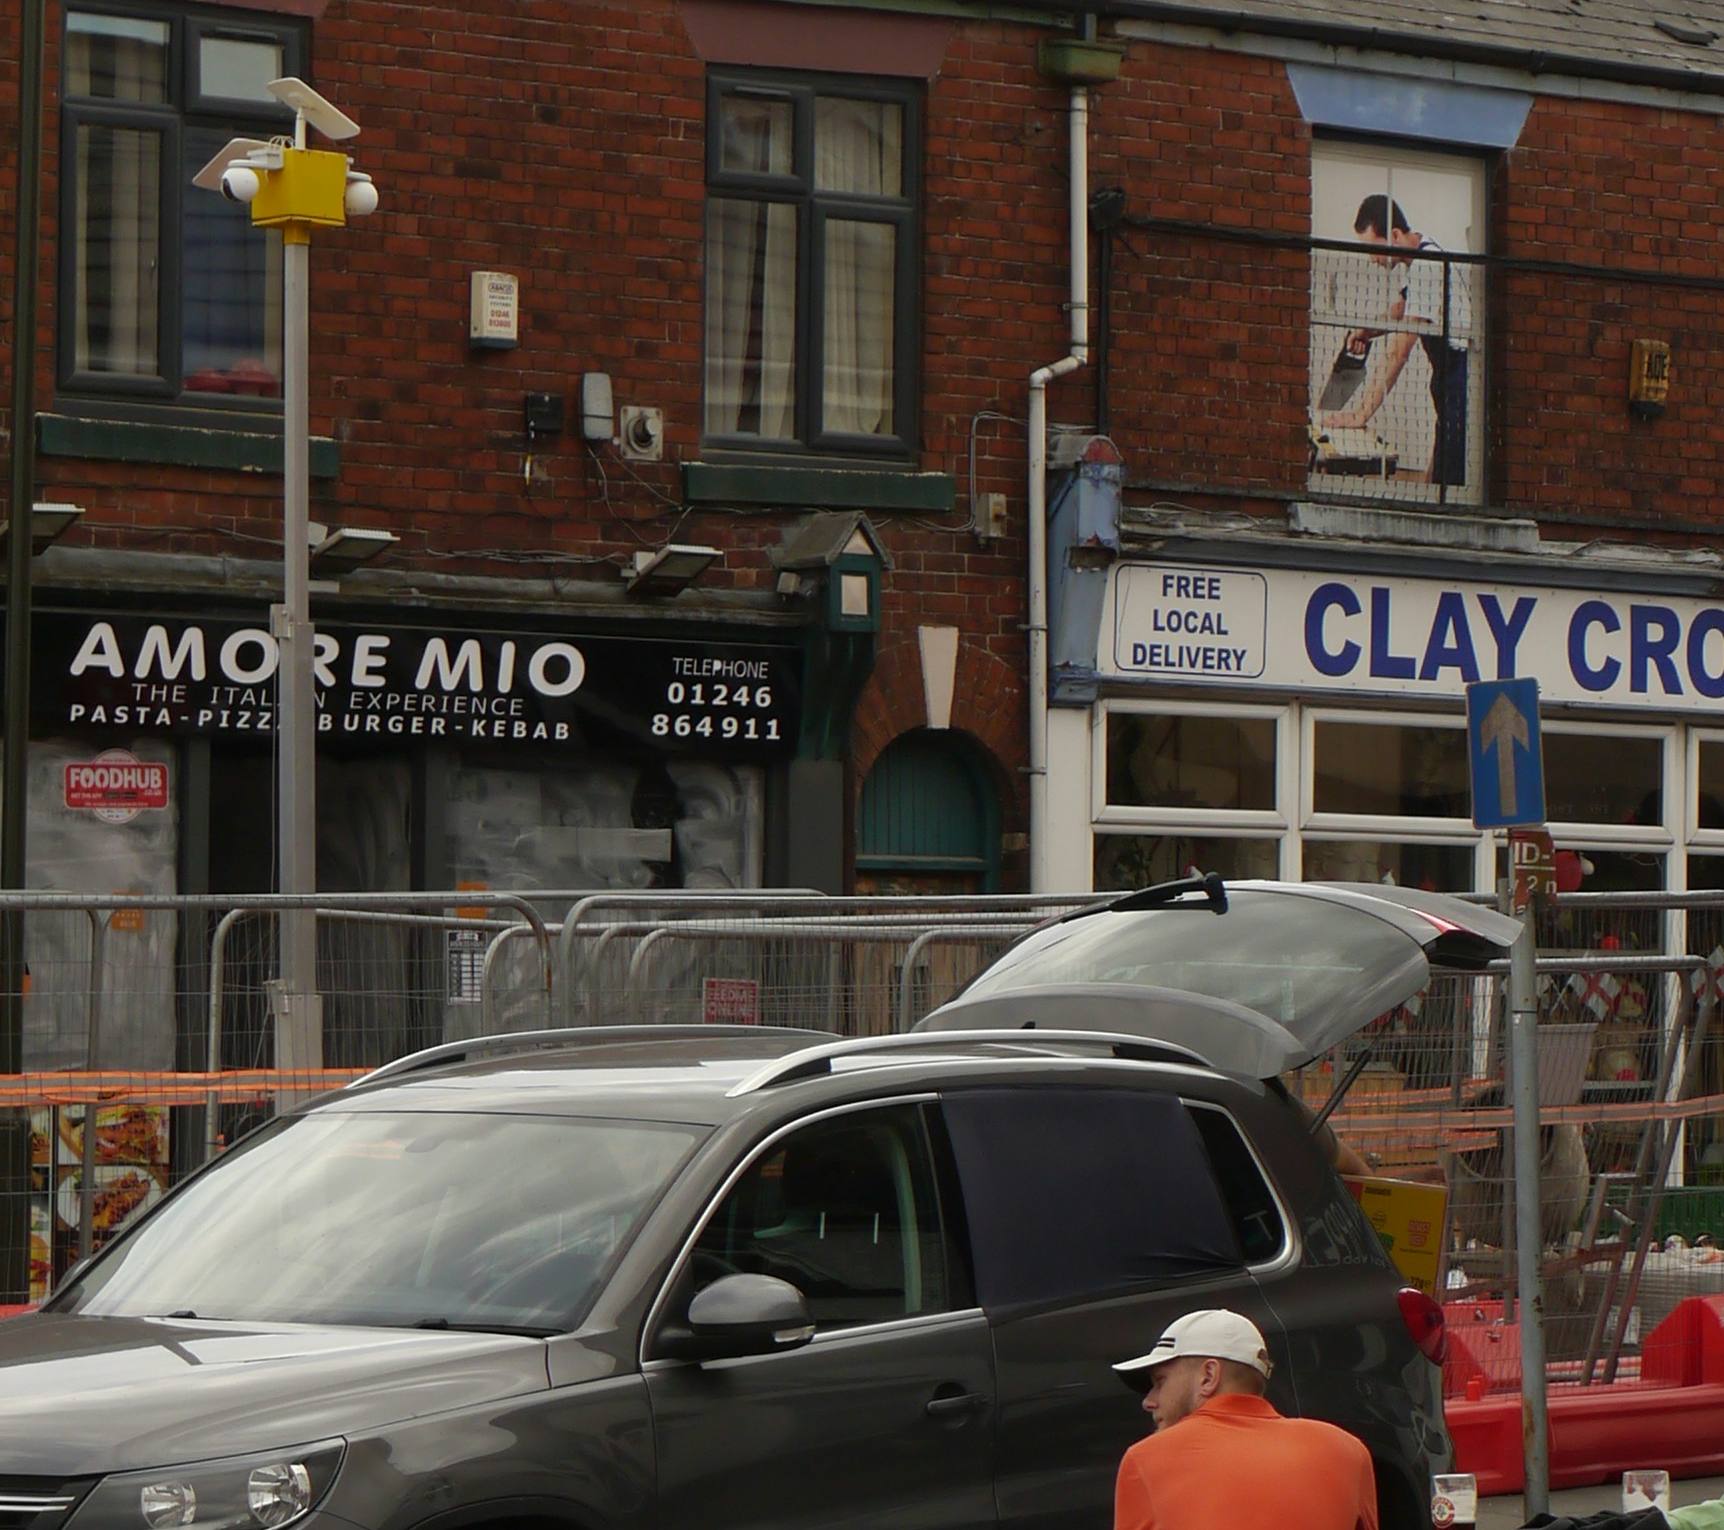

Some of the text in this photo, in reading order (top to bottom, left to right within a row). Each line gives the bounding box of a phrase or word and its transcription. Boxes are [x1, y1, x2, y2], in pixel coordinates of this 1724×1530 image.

[1162, 574, 1222, 601] FREE
[1153, 608, 1229, 636] LOCAL
[1304, 581, 1538, 683] CLAY
[69, 621, 586, 697] AMORE MIO
[672, 656, 769, 679] TELEPHONE
[1132, 642, 1247, 671] DELIVERY
[131, 683, 524, 716] THE ITALN EXPERIENCE
[667, 681, 772, 708] 01246
[651, 713, 781, 740] 864911
[70, 767, 162, 789] FOODHUB
